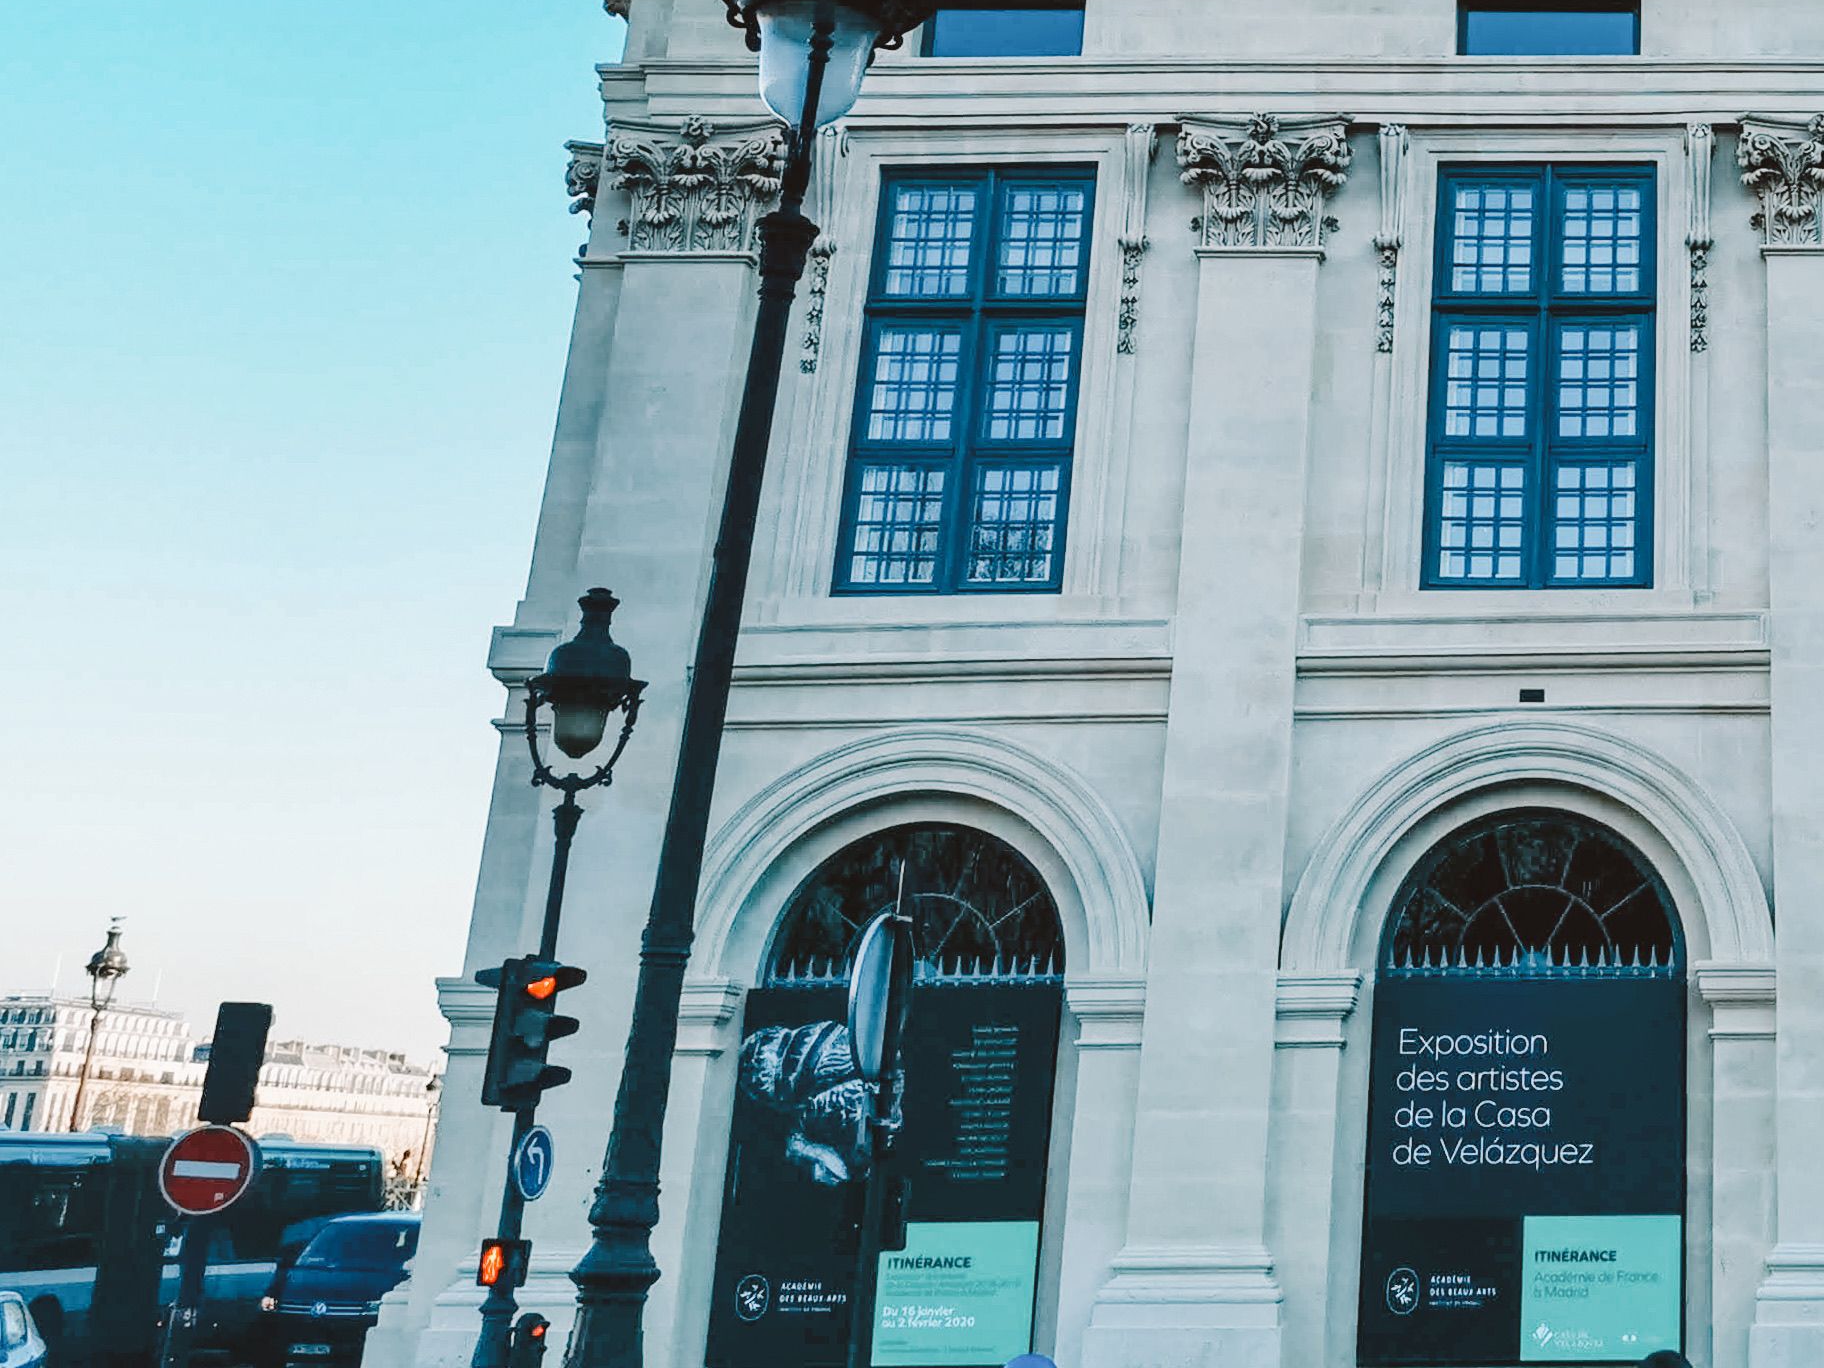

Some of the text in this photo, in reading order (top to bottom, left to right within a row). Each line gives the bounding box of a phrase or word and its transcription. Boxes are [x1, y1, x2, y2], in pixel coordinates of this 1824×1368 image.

[1399, 1028, 1548, 1061] Exposition
[1396, 1063, 1564, 1091] des artistes
[1394, 1099, 1550, 1128] de la Casa
[1392, 1136, 1594, 1172] de Velázquez
[887, 1254, 972, 1269] ITINÉRANCE
[1534, 1247, 1617, 1263] ITINÉRANCE
[1430, 1274, 1471, 1284] ACADÉMIE
[1534, 1270, 1659, 1283] Académie de France
[780, 1280, 822, 1291] ACADÉMIE
[1429, 1287, 1445, 1297] DES
[1544, 1286, 1589, 1298] Madrid
[882, 1305, 955, 1318] Du 16 janvier
[881, 1316, 975, 1328] au 2 février 2020
